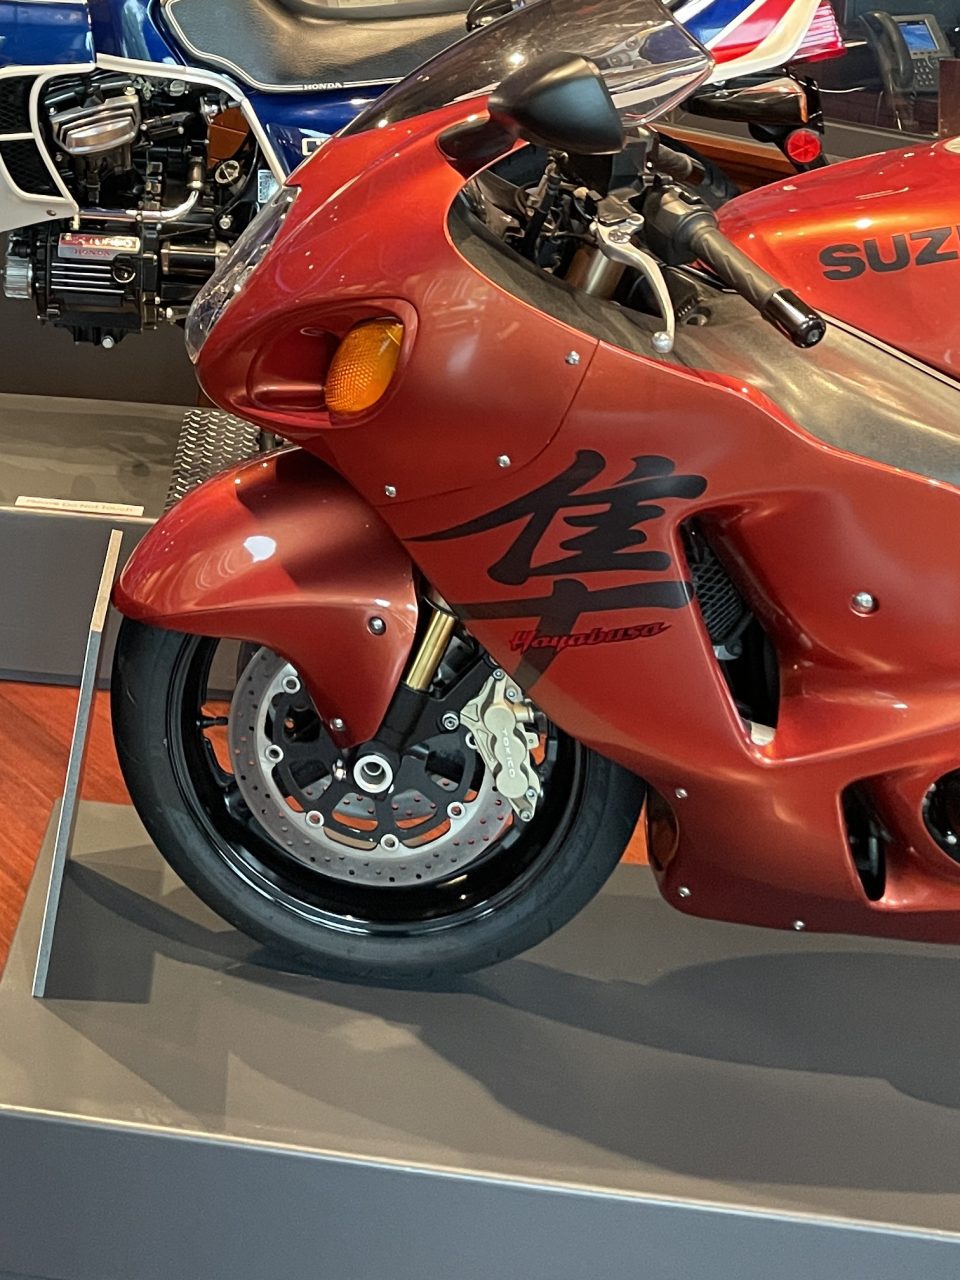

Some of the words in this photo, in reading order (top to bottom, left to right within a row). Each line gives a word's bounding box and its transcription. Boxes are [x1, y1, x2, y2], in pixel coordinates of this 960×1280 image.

[303, 82, 344, 91] HONDA
[818, 225, 960, 282] SUZ
[509, 622, 672, 655] Hayabusa
[502, 727, 516, 778] TOKICO
